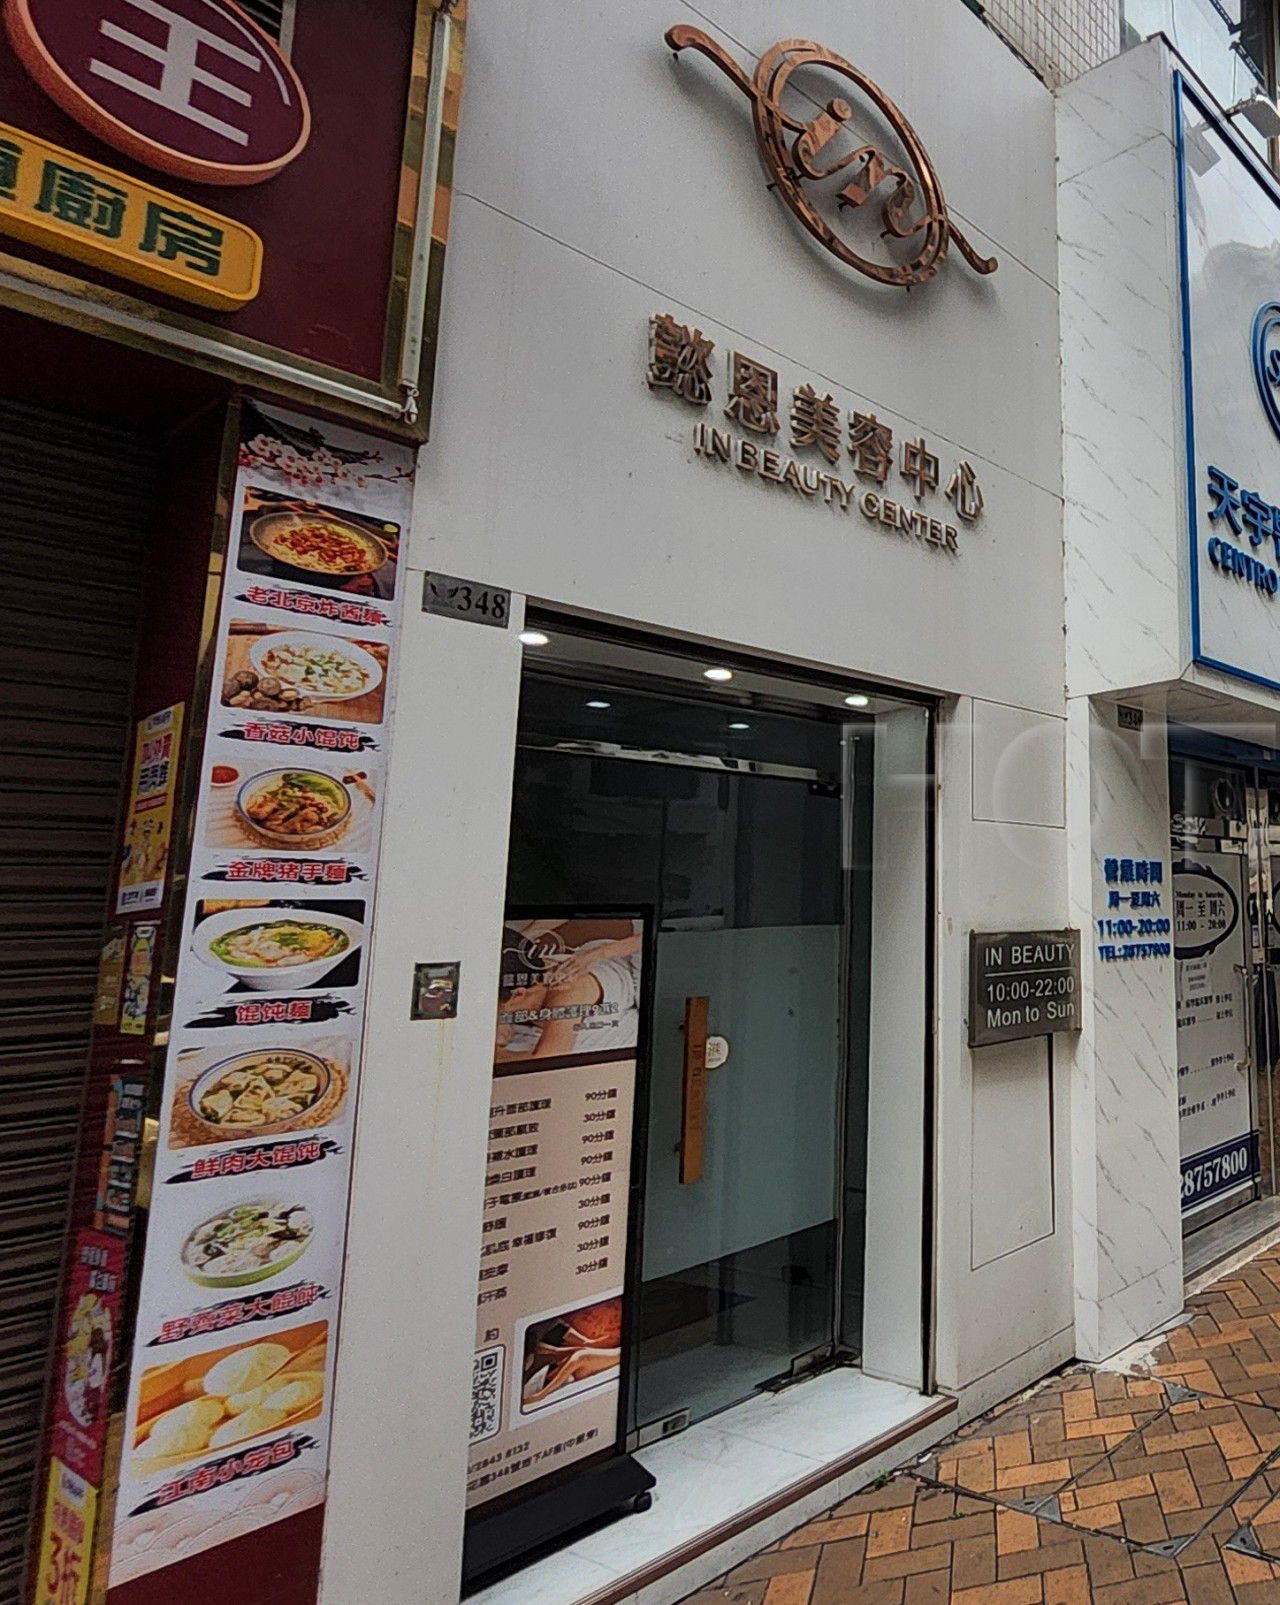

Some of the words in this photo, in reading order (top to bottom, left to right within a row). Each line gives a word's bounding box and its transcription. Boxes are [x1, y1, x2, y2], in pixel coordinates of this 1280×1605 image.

[646, 311, 986, 523] 懿恩美容中心
[692, 422, 732, 461] IN
[735, 438, 856, 509] BEAUTY
[859, 492, 960, 552] CENTER
[1207, 537, 1278, 594] CENTRO
[457, 586, 506, 619] 348
[1097, 918, 1171, 938] 11:00-20:00
[985, 945, 1003, 966] IN
[1011, 943, 1076, 965] BEAUTY
[986, 977, 1075, 1002] 10:00-22:00
[987, 1007, 1022, 1029] Mon
[1025, 1005, 1040, 1023] to
[1046, 1001, 1075, 1020] Sun
